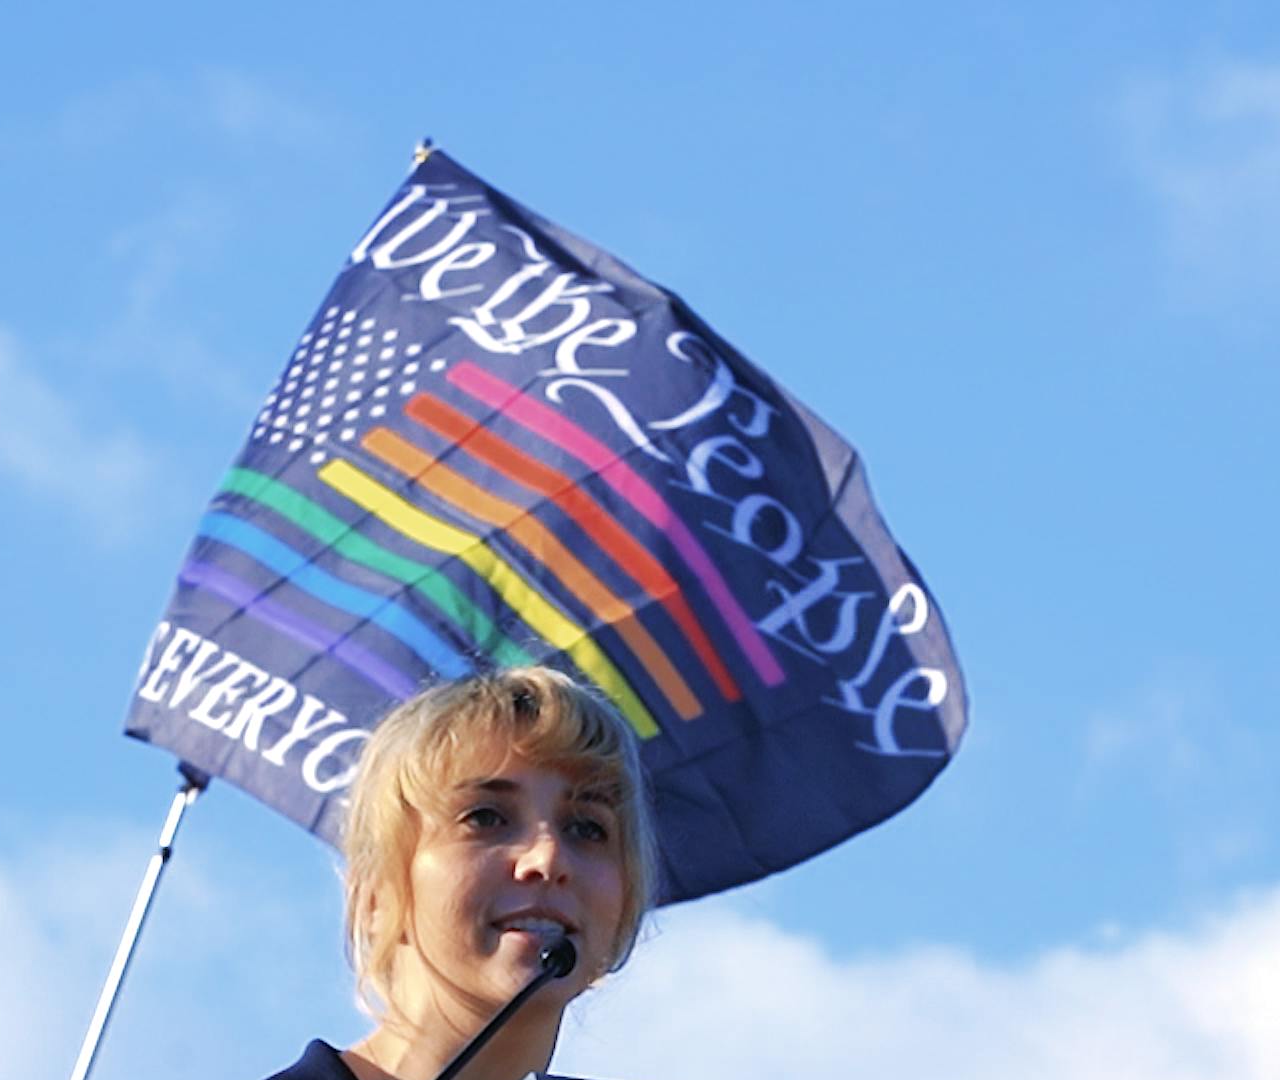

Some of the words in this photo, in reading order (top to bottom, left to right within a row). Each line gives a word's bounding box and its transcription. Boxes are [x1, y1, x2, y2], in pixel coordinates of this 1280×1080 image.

[350, 183, 496, 301] We
[546, 330, 948, 758] People
[139, 626, 372, 808] EVERYO
